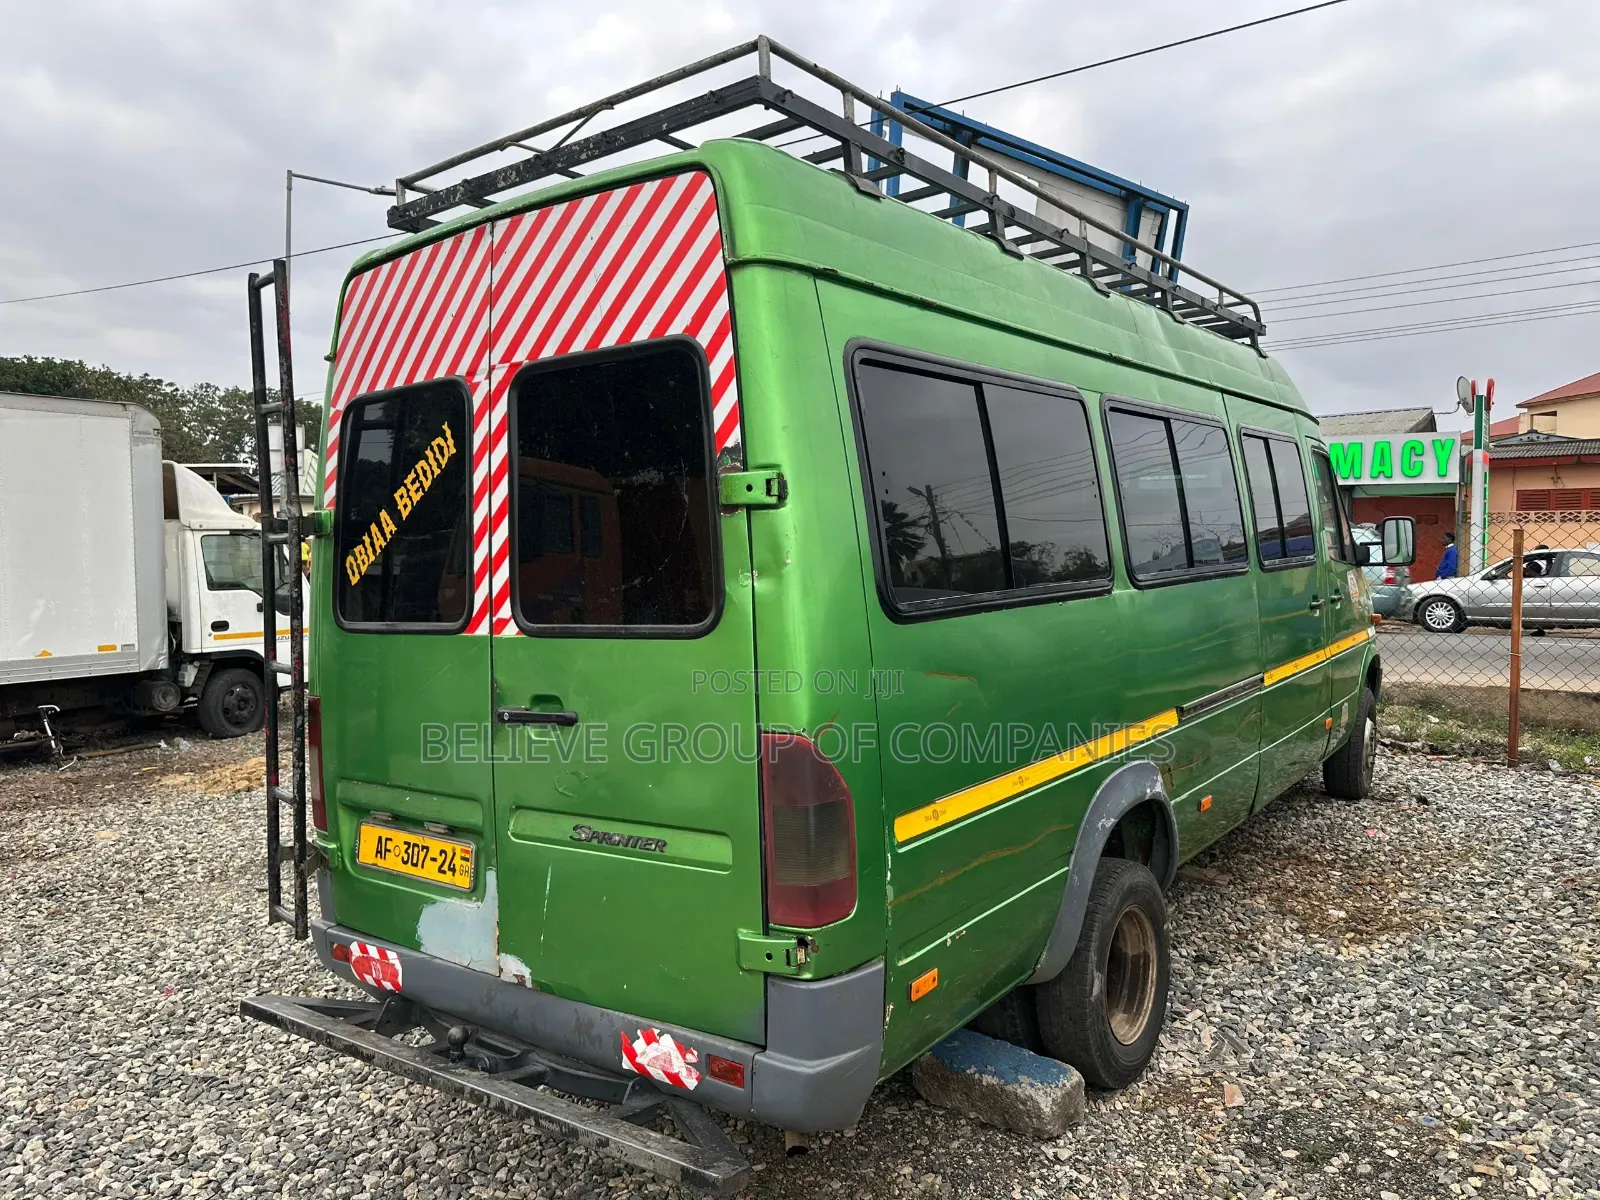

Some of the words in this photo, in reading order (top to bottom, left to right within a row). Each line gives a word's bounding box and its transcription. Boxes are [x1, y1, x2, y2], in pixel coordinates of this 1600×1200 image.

[345, 508, 398, 586] OBIAA
[393, 421, 457, 521] BEDIDI
[375, 835, 392, 860] AF
[401, 840, 457, 877] 307-24
[459, 863, 470, 878] GH
